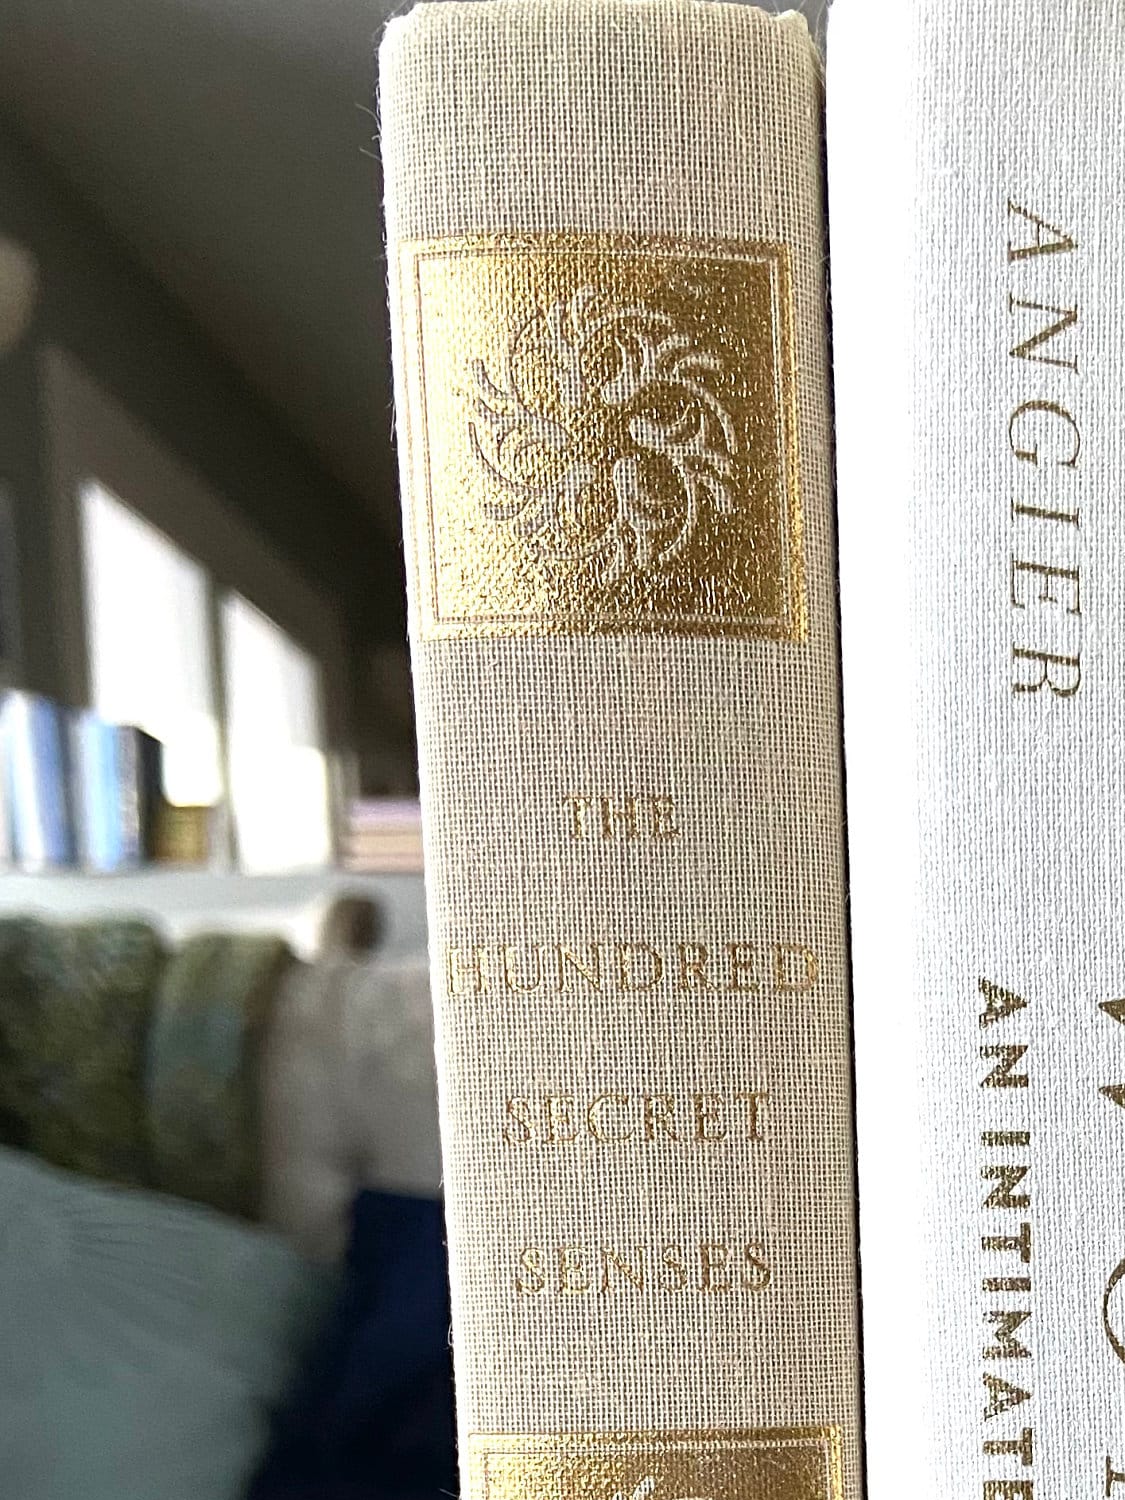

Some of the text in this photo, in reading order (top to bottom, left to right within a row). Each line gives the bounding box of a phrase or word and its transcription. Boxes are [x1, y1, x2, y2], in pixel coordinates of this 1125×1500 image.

[1007, 198, 1081, 699] ANGIER
[562, 796, 682, 840] THE
[446, 941, 819, 996] HUNDRED
[978, 977, 1028, 1088] AN
[501, 1092, 770, 1145] SECRET
[514, 1242, 773, 1296] SENSES
